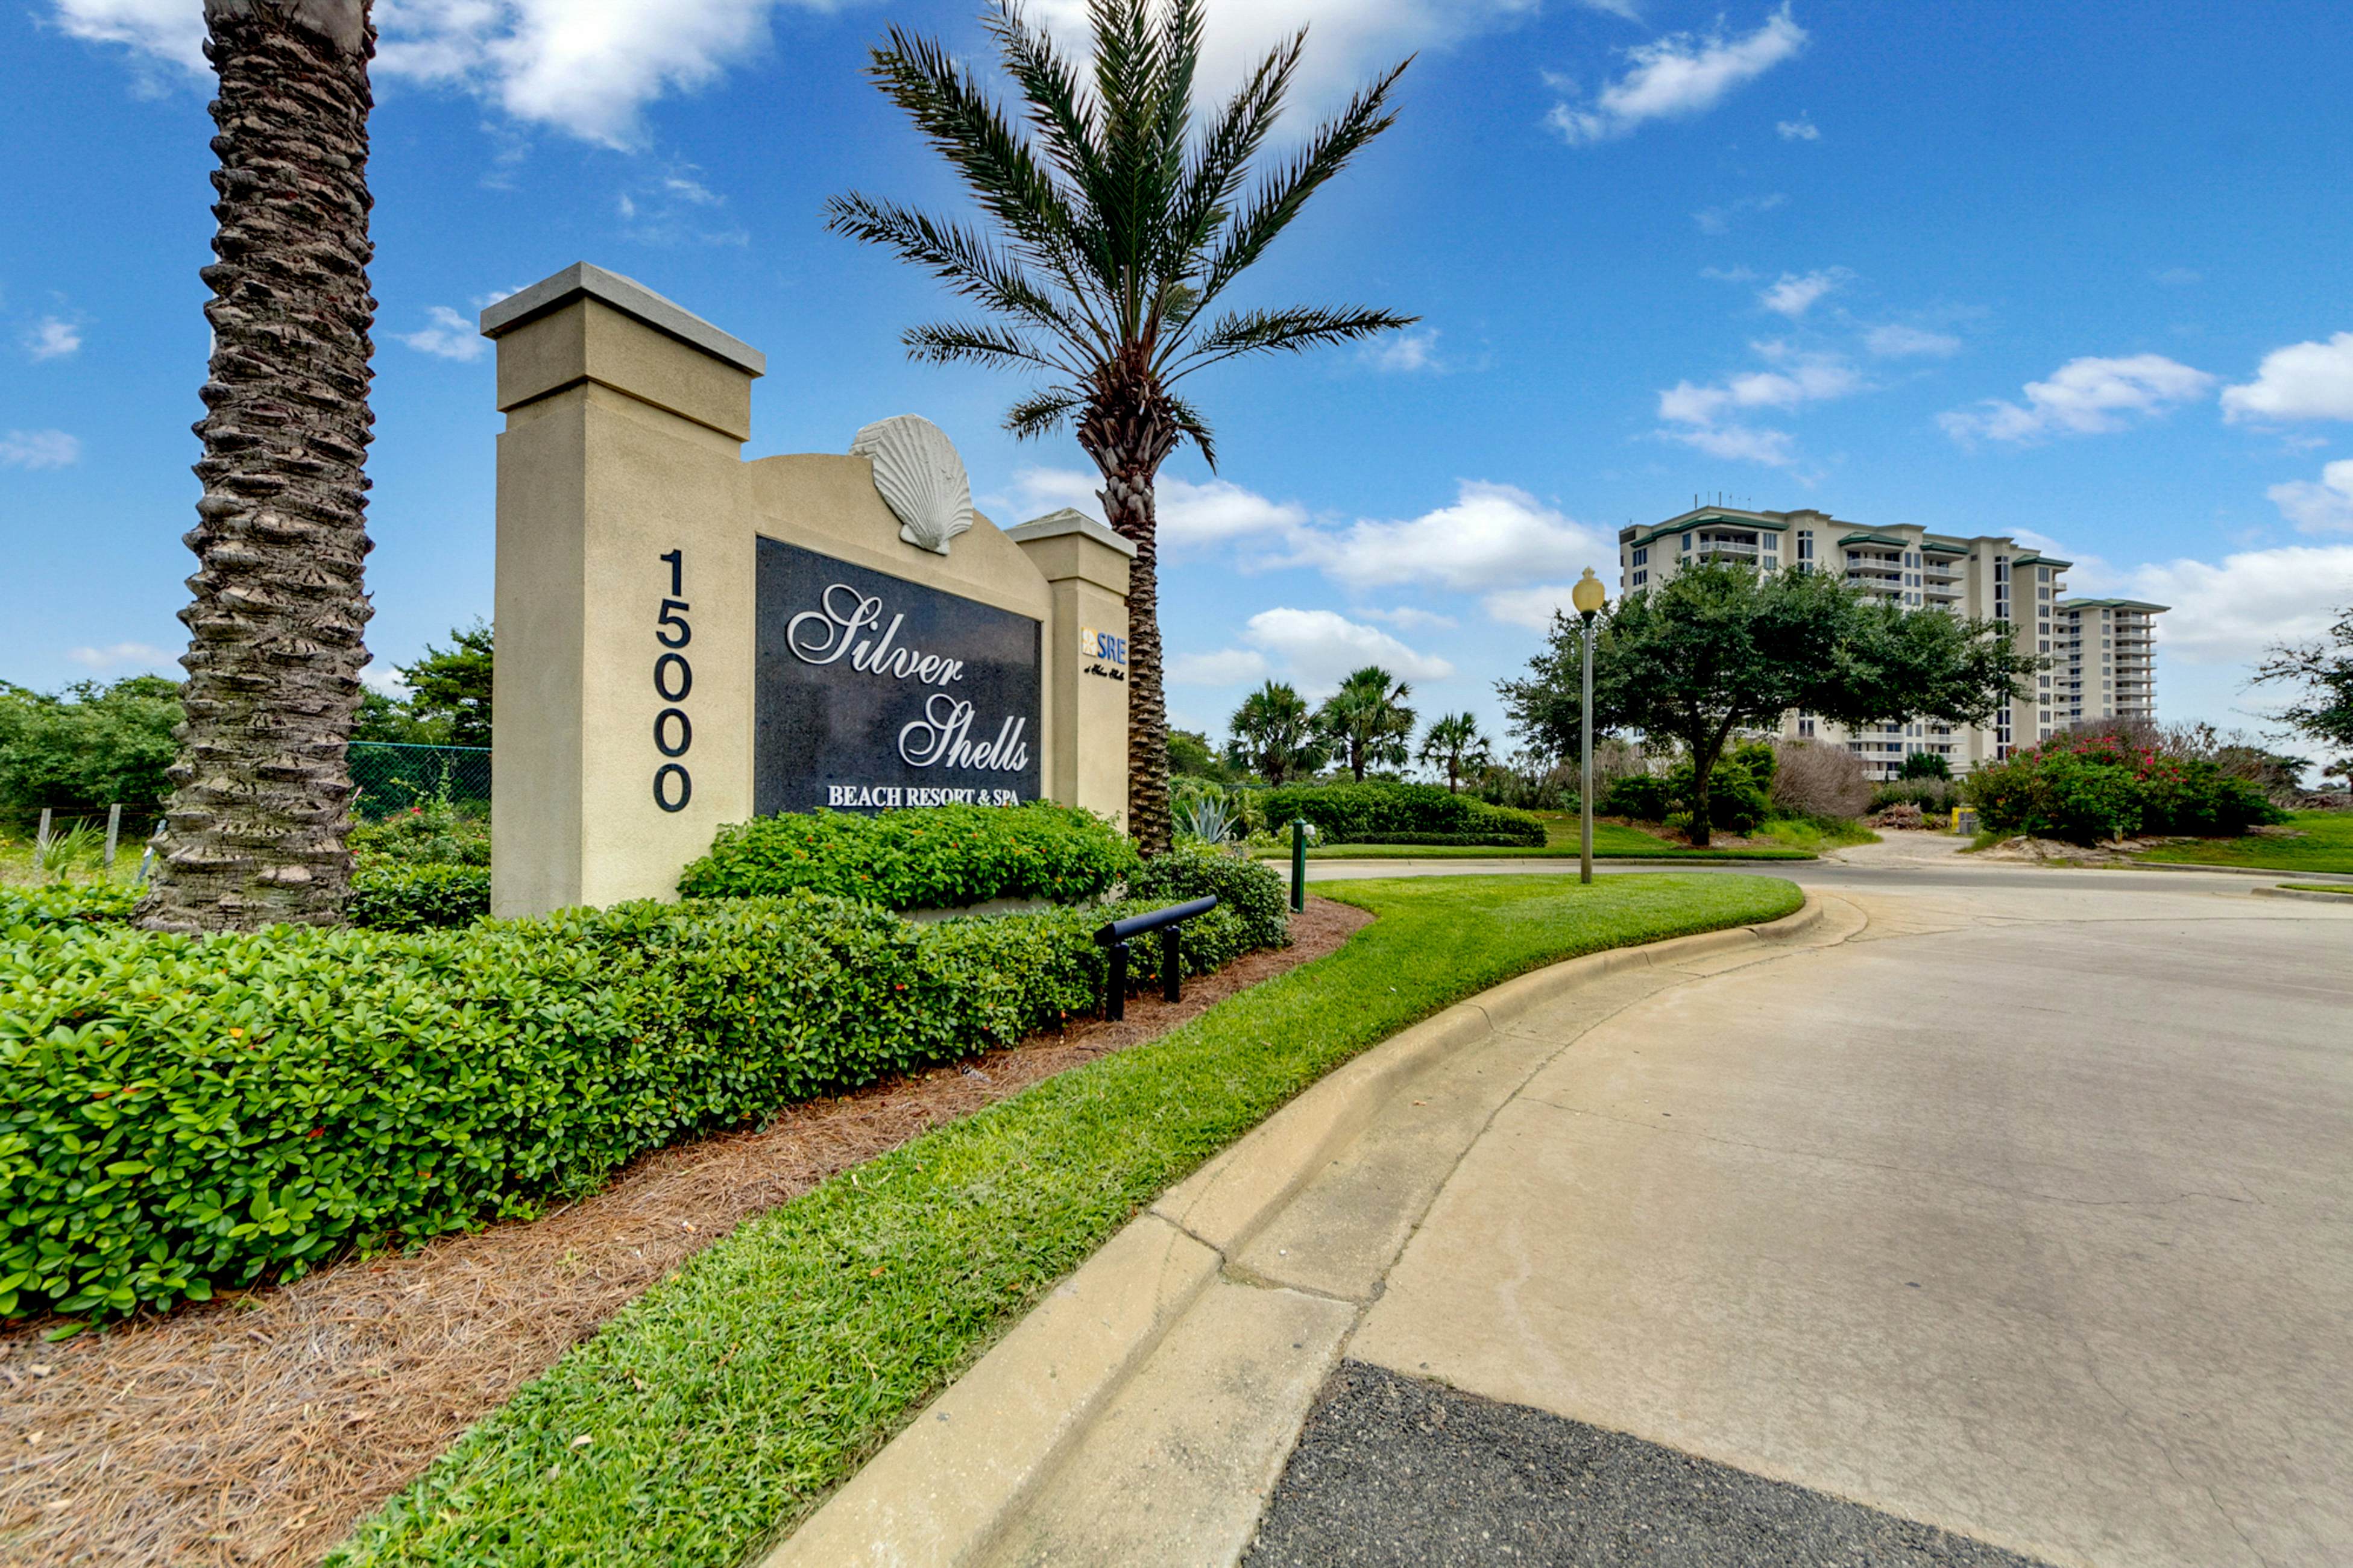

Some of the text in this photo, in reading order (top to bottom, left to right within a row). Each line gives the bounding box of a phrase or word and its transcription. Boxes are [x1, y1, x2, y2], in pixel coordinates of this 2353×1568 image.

[786, 584, 964, 687] Silver
[1097, 632, 1126, 665] SRE
[653, 549, 692, 814] 15000
[898, 693, 1028, 772] Shells
[828, 786, 1020, 807] BEACH RESORT & SPA
